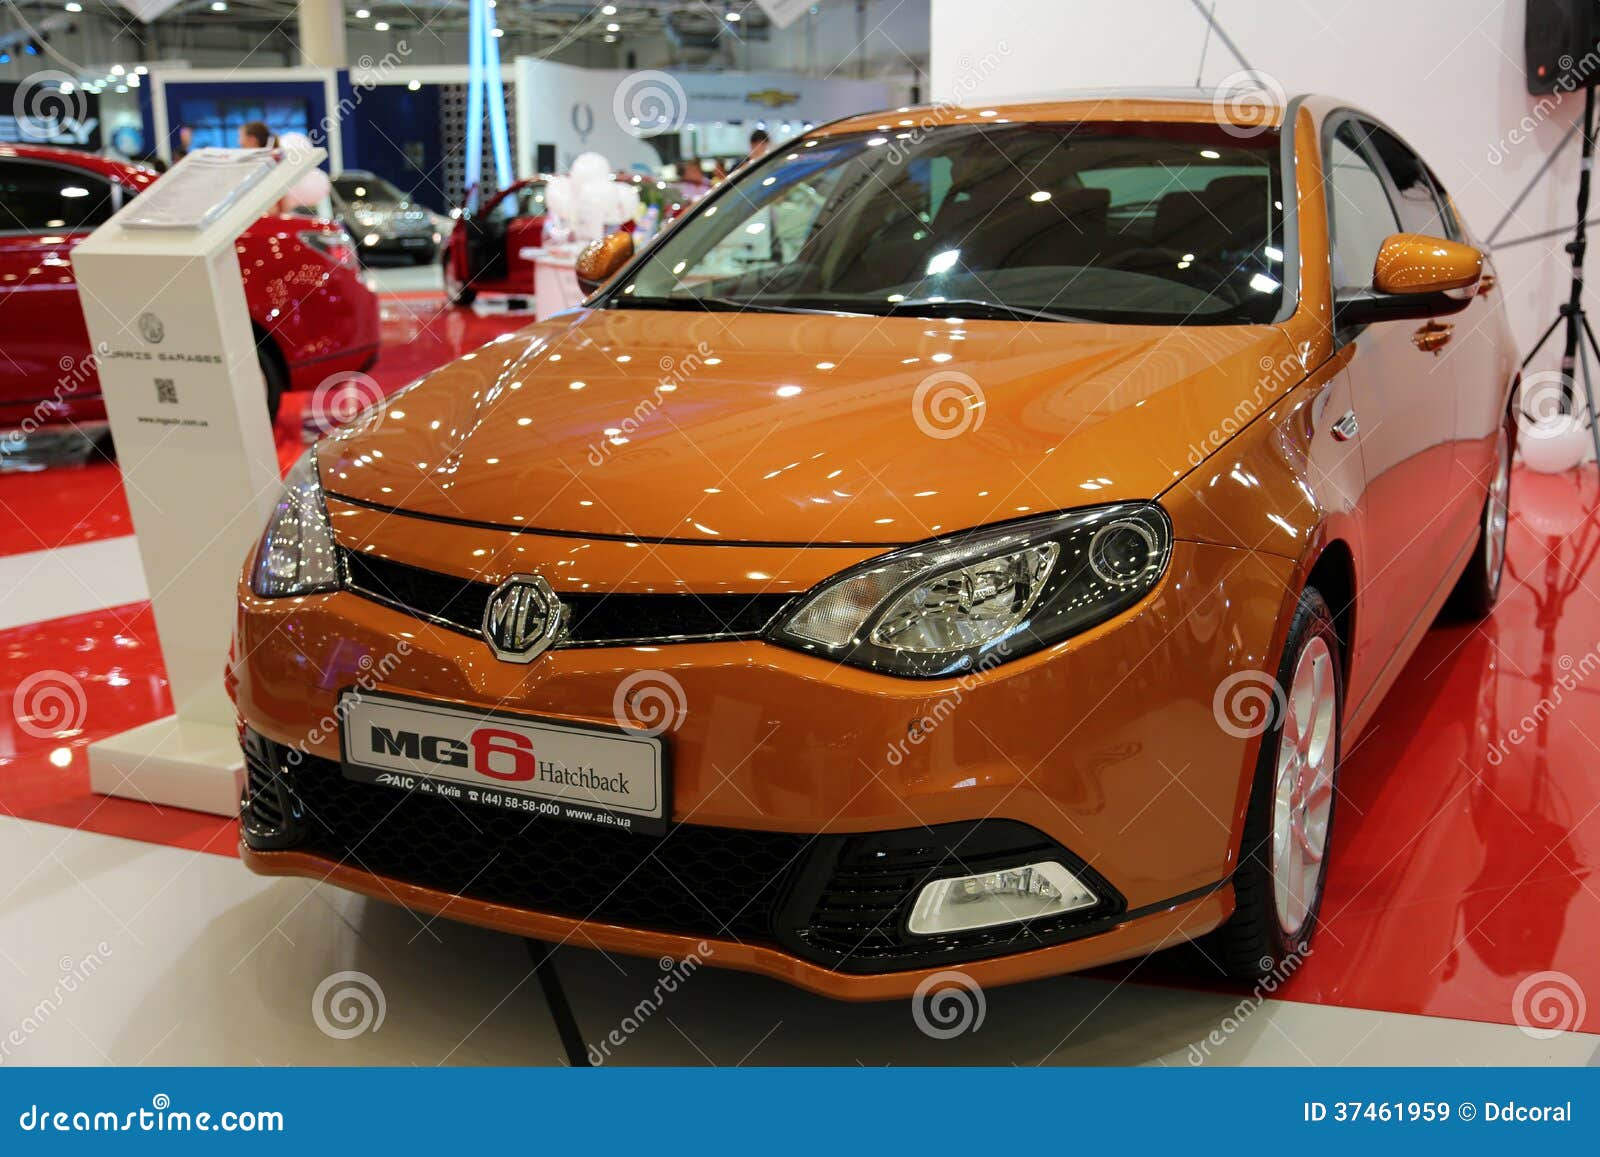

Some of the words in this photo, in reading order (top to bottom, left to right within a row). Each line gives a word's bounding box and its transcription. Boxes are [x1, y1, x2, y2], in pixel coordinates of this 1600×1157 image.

[538, 761, 630, 794] Hatchback
[437, 783, 461, 798] Київ
[481, 791, 502, 807] (44)
[505, 797, 560, 816] 58-58-000
[566, 808, 631, 828] www.ais.ua
